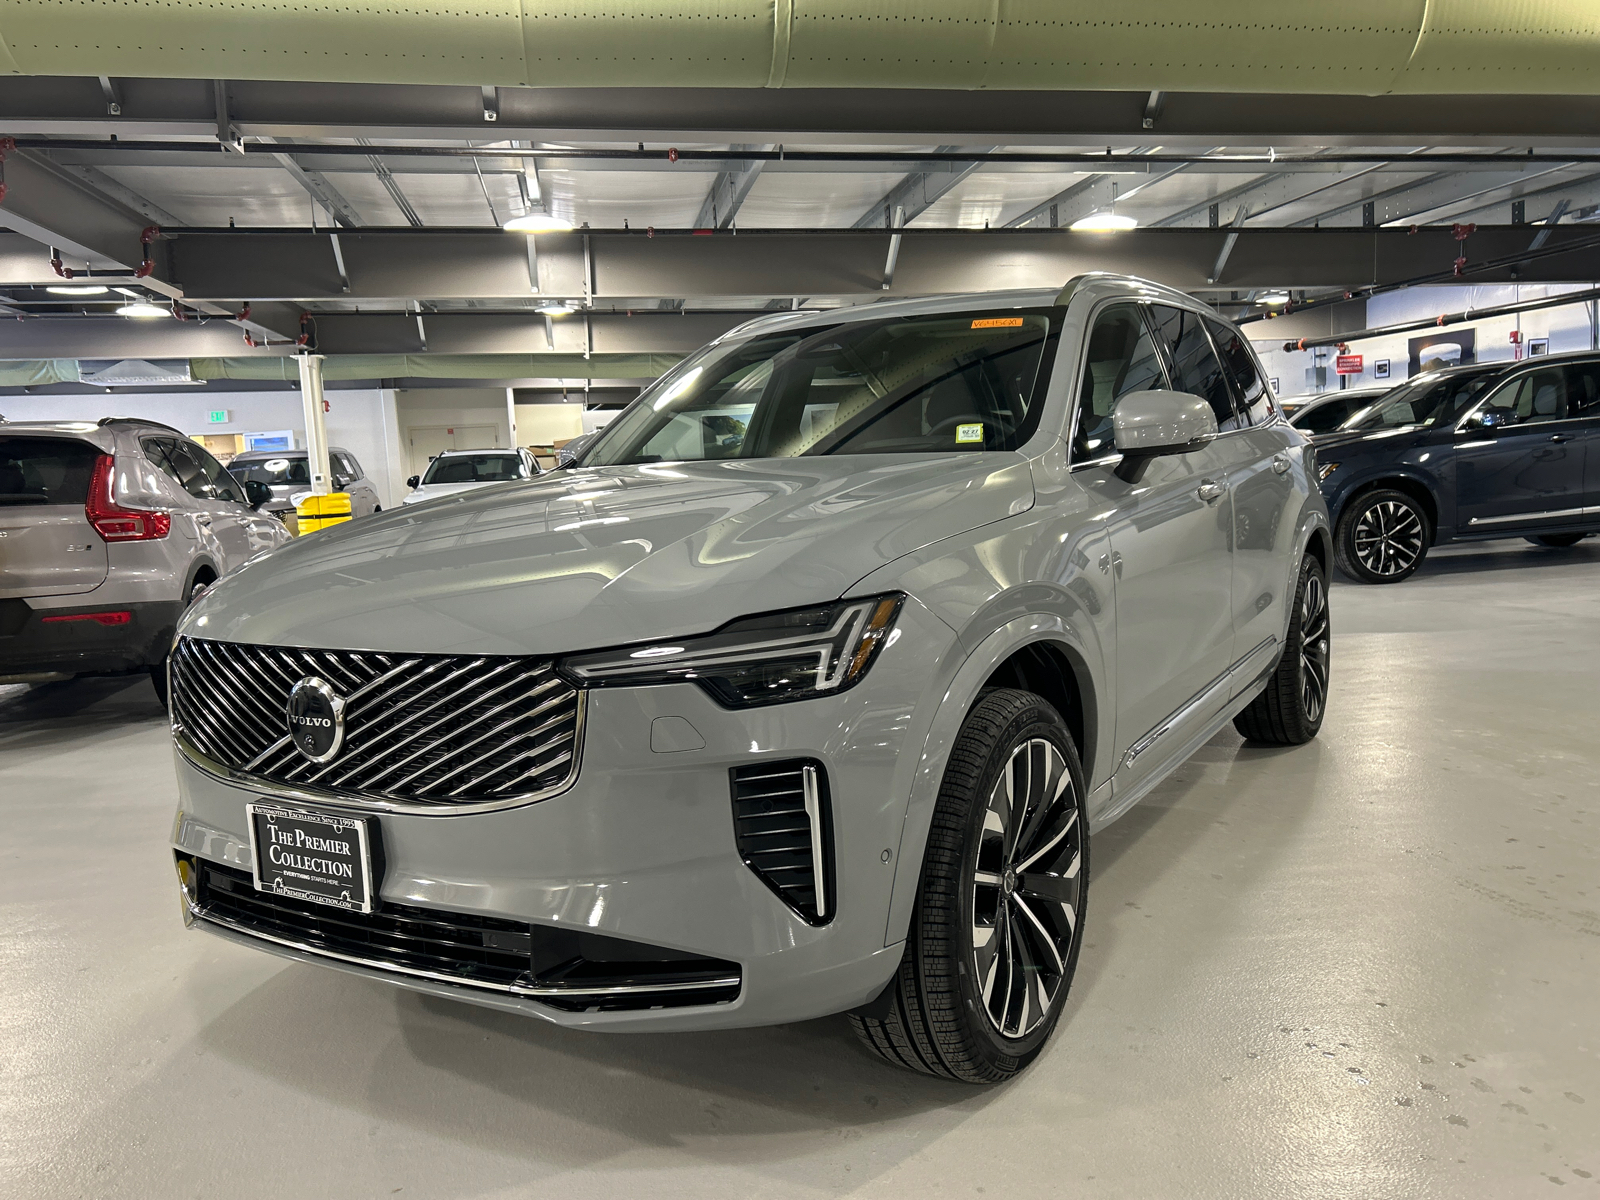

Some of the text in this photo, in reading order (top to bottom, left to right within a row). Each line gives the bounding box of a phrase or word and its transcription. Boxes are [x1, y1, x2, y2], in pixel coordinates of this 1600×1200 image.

[291, 715, 331, 727] VOLVO
[255, 806, 288, 817] AUTOMOTIVE
[321, 816, 338, 825] SINCE
[340, 819, 355, 828] 1995
[267, 824, 351, 856] THE PREMIER
[269, 844, 353, 878] COLLECTION
[283, 870, 311, 880] EVERYTHING
[311, 875, 327, 884] STARTS
